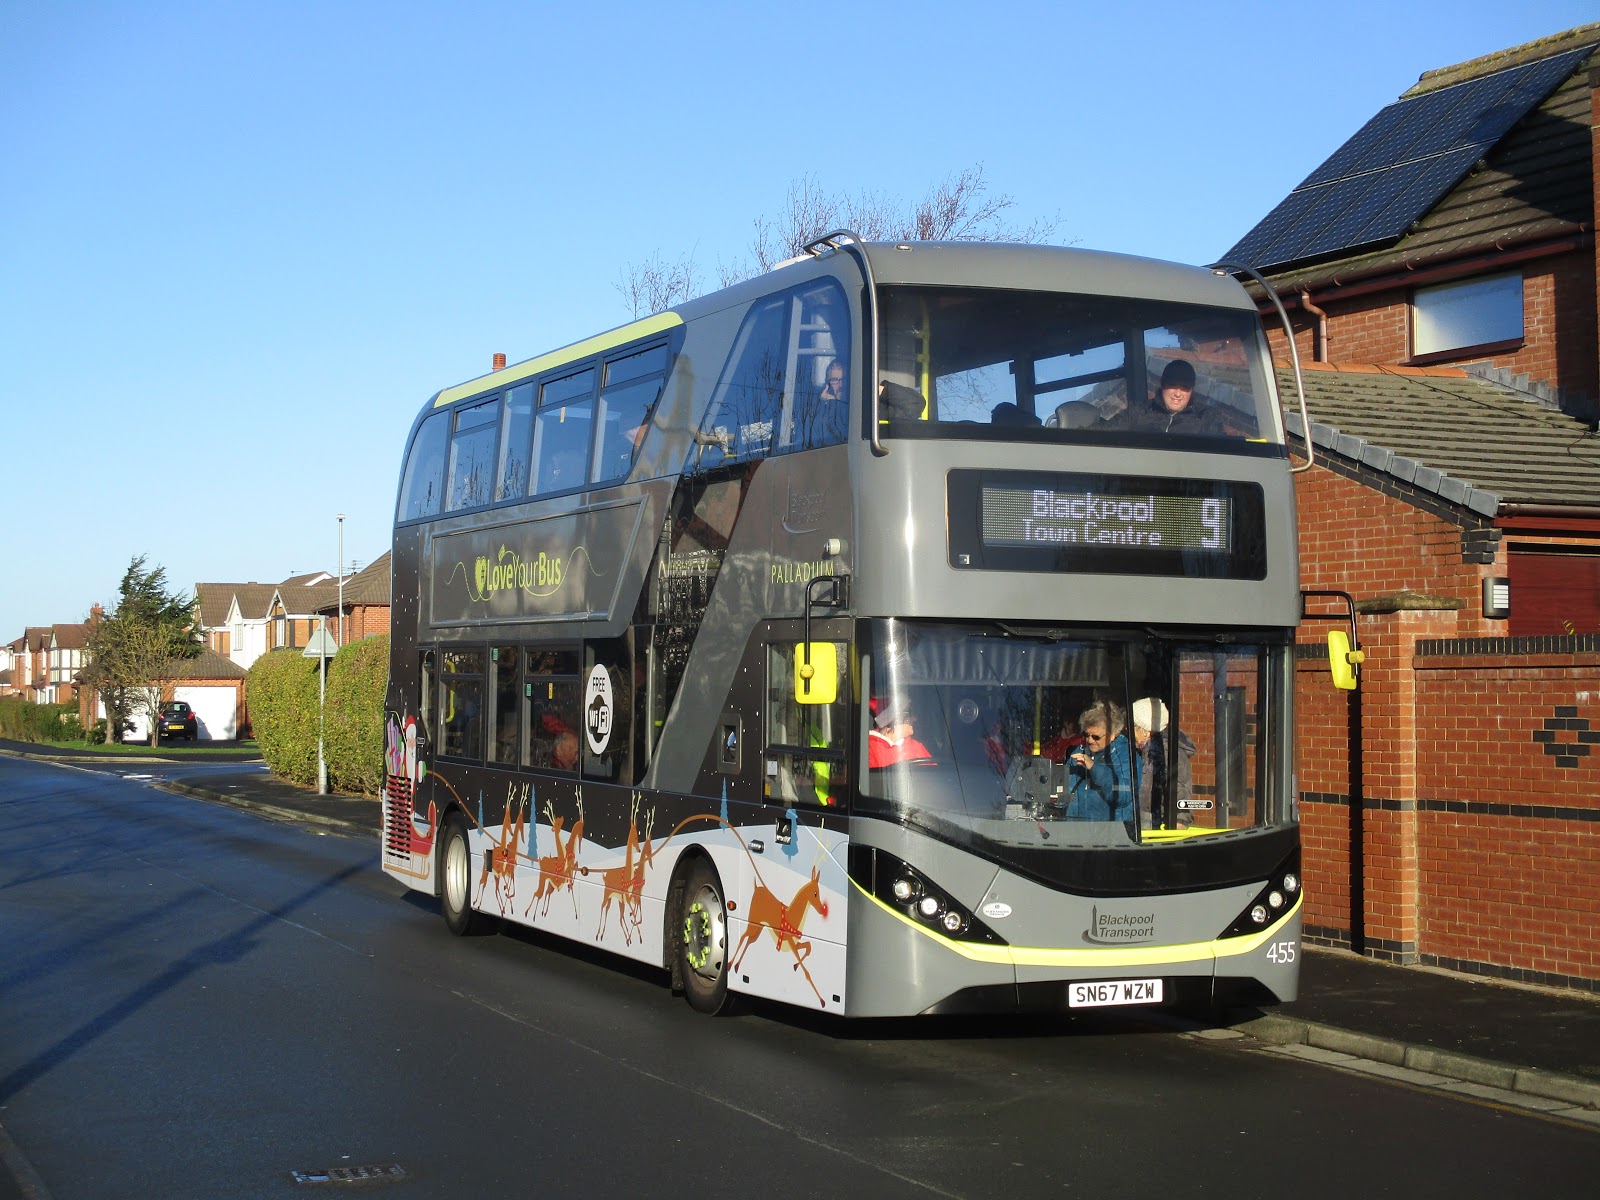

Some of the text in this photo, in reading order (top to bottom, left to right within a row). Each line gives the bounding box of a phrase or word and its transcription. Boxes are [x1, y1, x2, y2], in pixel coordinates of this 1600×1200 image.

[1033, 489, 1154, 522] Blackpool
[1022, 518, 1162, 546] Town Centre
[1201, 498, 1220, 548] 9
[771, 560, 834, 584] PALLADIUM
[592, 677, 606, 692] FREE
[1099, 913, 1155, 926] Blackpool
[1099, 926, 1155, 939] Transport
[1266, 941, 1296, 964] 455
[1076, 982, 1154, 1002] SN67 WZW
